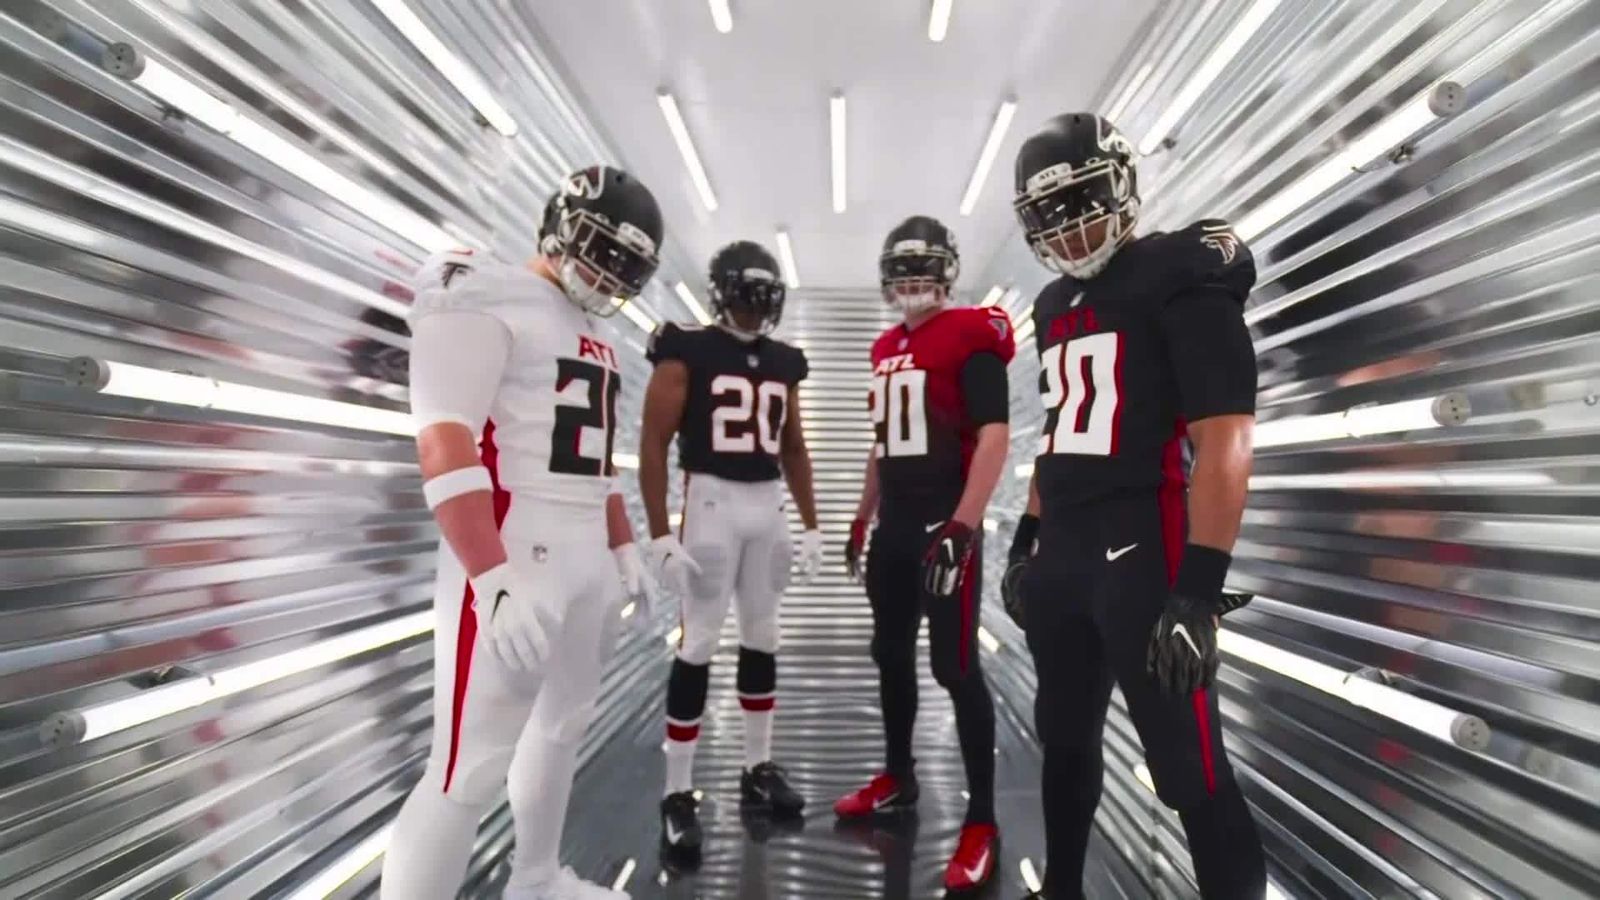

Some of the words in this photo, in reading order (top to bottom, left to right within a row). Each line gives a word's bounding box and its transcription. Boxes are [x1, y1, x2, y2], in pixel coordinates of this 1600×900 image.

[1044, 308, 1098, 344] ATL
[874, 353, 915, 376] ATL
[711, 374, 788, 455] 20
